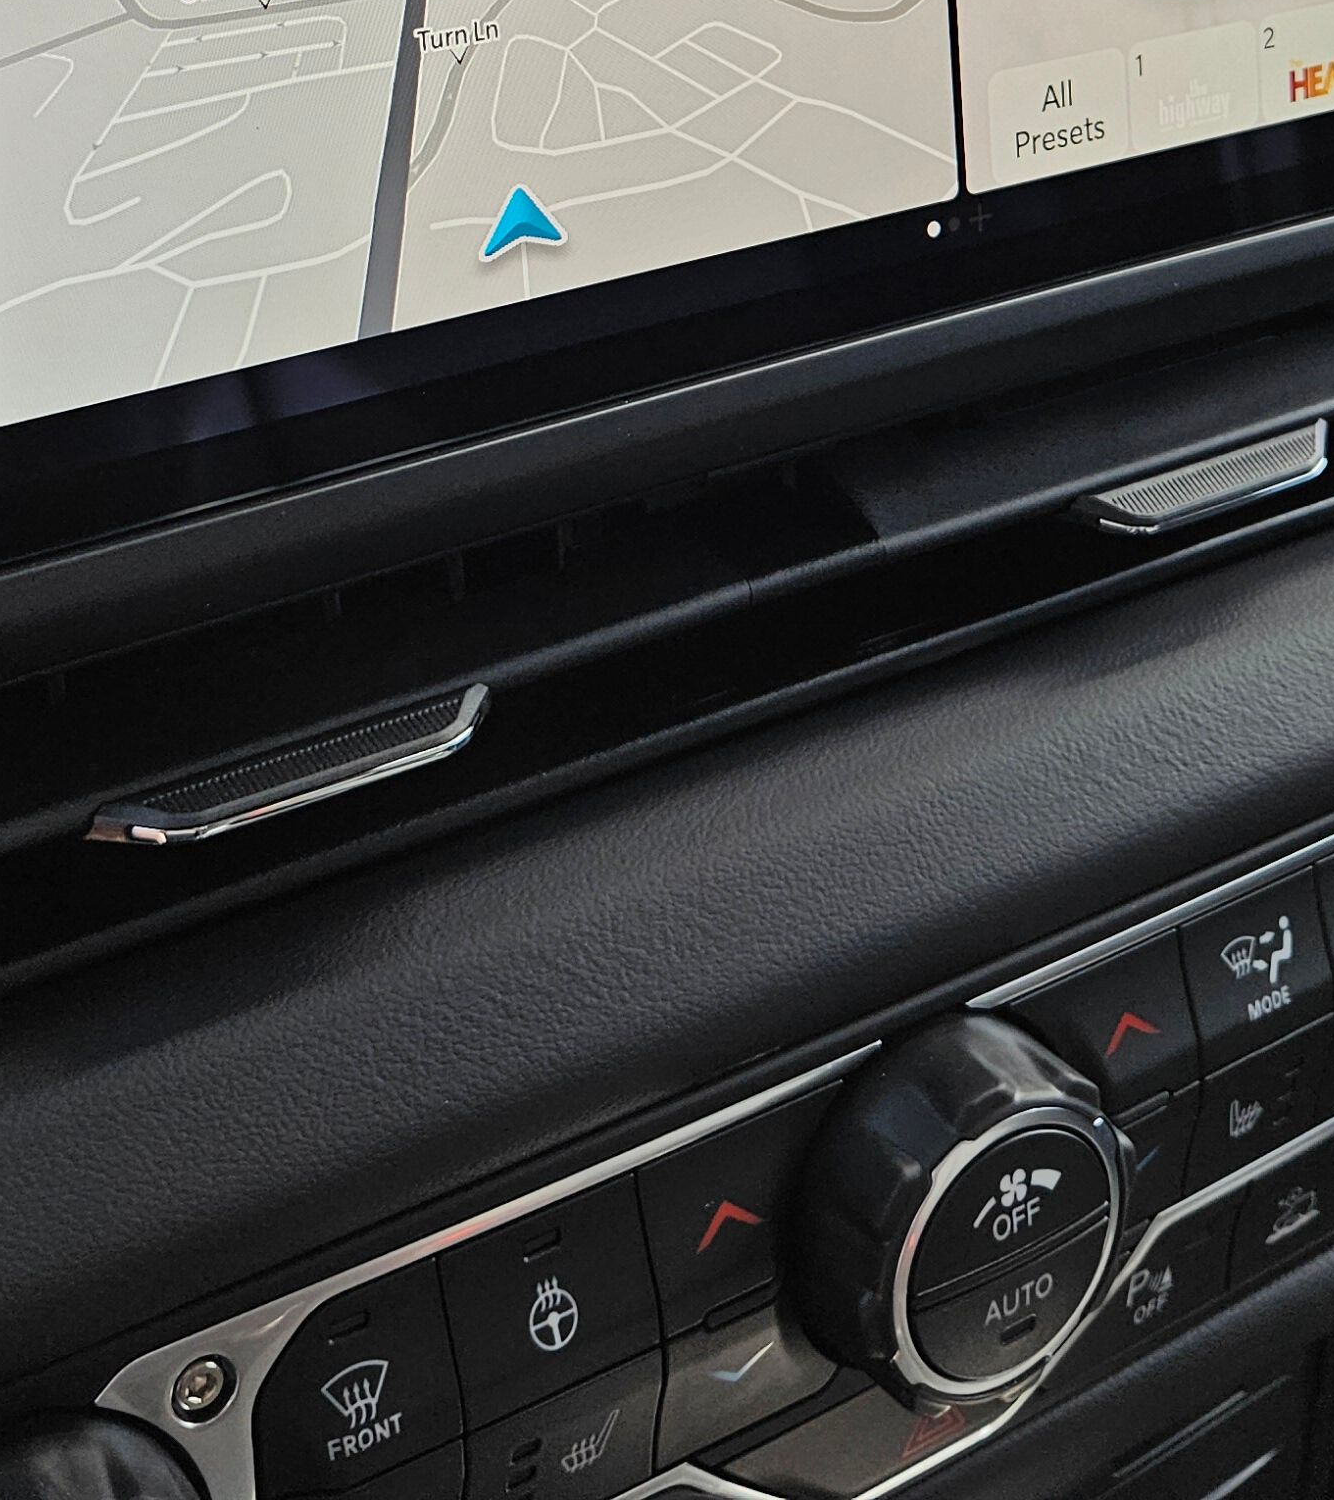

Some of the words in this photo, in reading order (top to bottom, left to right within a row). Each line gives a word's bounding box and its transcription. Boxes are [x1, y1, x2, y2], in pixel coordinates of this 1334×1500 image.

[418, 27, 466, 51] Turn
[474, 23, 499, 43] Ln
[1264, 27, 1276, 50] 2
[1136, 54, 1144, 76] 1
[1041, 81, 1073, 112] All
[1015, 118, 1105, 158] Presets
[1248, 986, 1291, 1020] MODE
[992, 1197, 1040, 1241] OFF
[984, 1273, 1053, 1325] AUTO
[1134, 1292, 1169, 1324] OFF
[327, 1411, 402, 1461] FRONT
